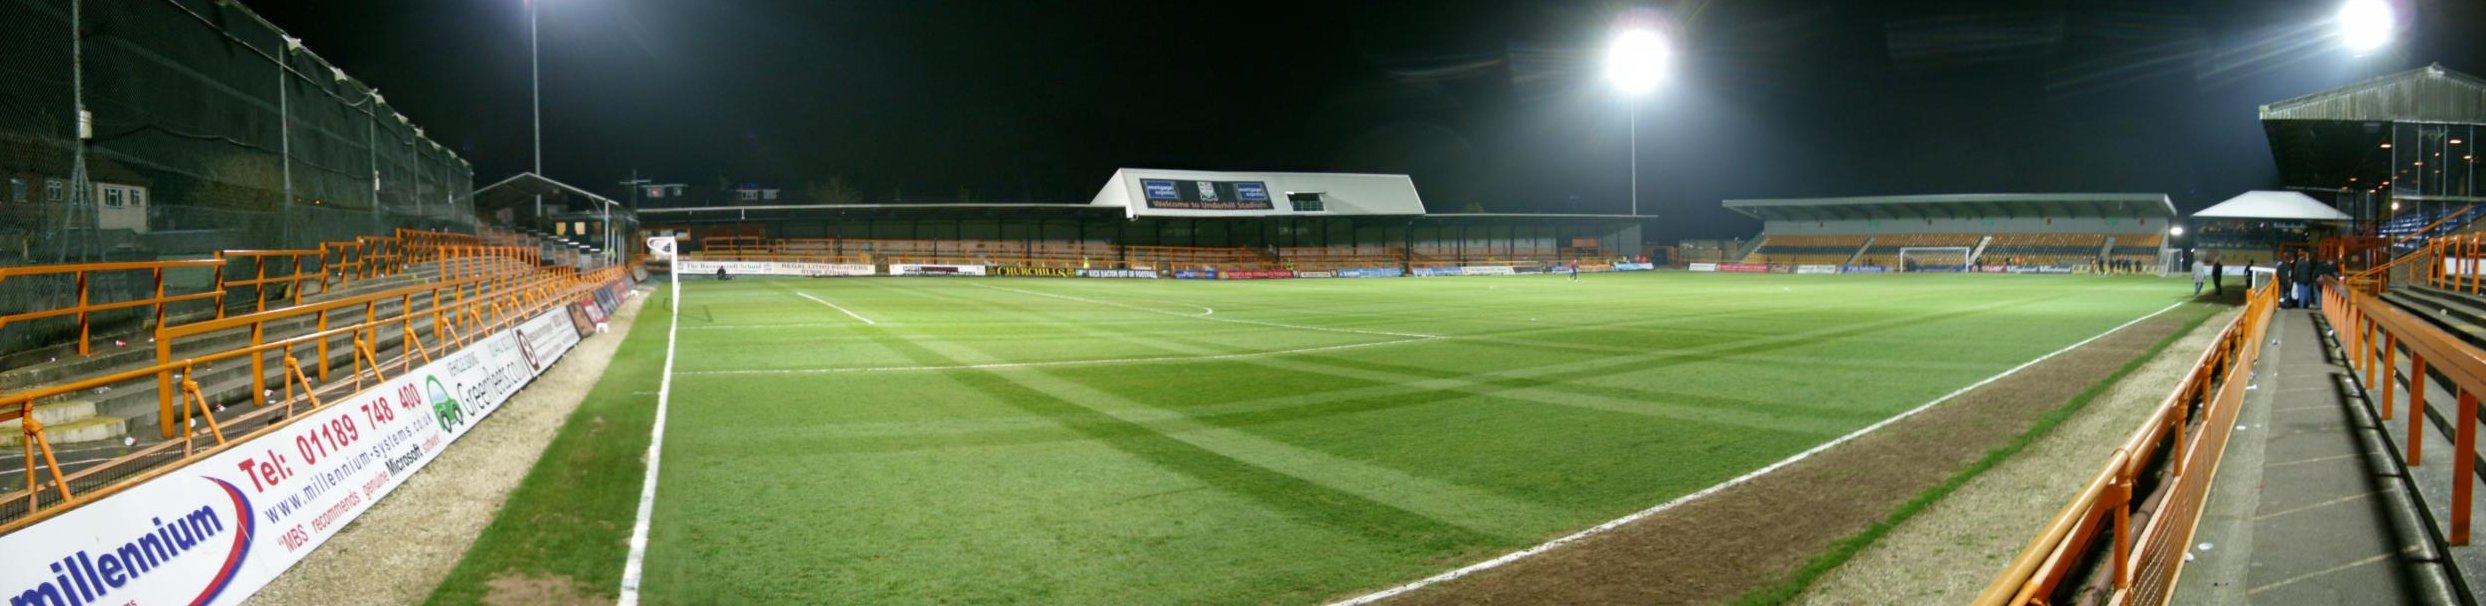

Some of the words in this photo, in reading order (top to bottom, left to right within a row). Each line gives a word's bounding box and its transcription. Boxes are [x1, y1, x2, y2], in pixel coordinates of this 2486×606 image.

[1152, 200, 1191, 208] Welcome
[997, 266, 1066, 276] CHURCHILLS
[1135, 270, 1158, 278] FOOTBALL
[238, 449, 293, 493] Tel:
[296, 414, 359, 465] 01189
[361, 396, 394, 430] 748
[398, 382, 422, 411] 400
[264, 411, 434, 525] www.millennium-systems.co.uk
[311, 490, 361, 534] recommends
[362, 469, 391, 501] genuine
[385, 443, 424, 478] Microsoft
[9, 505, 223, 606] millennium
